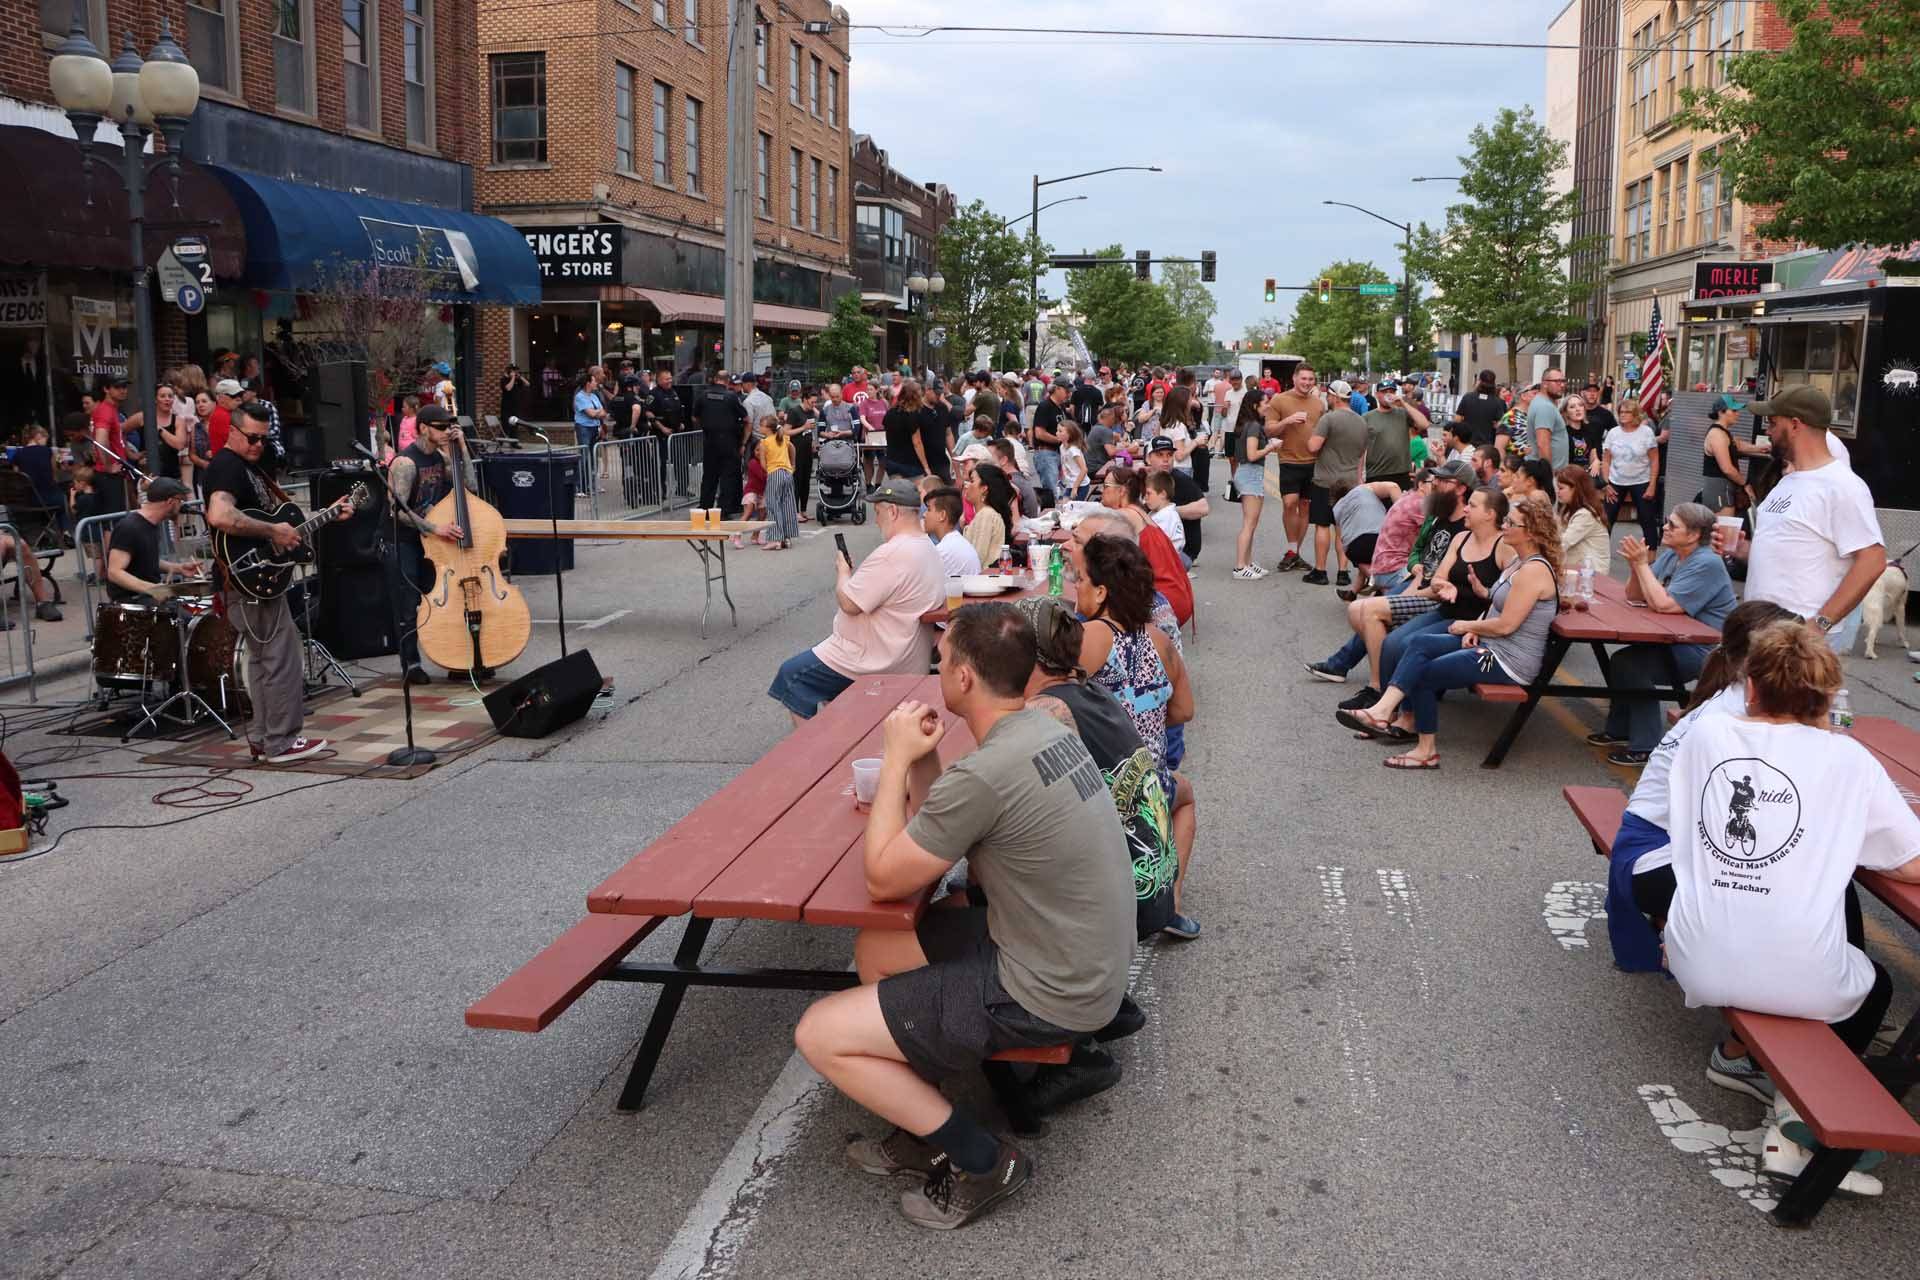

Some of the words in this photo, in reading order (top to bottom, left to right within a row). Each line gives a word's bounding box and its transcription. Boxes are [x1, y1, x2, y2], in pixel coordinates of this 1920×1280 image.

[375, 239, 411, 264] Scott
[198, 263, 213, 283] 2
[538, 262, 555, 276] T.
[562, 262, 613, 276] STORE
[1711, 268, 1759, 285] MERLE
[1699, 288, 1760, 300] NORM
[72, 311, 128, 358] Male
[76, 360, 128, 376] Fashions
[1032, 732, 1090, 788] AMERIC
[1068, 756, 1105, 802] MAD
[1757, 787, 1794, 805] ride
[1711, 850, 1744, 870] Critical
[1746, 860, 1769, 870] Mass
[1769, 848, 1791, 864] Ride
[1729, 870, 1753, 880] Memory
[1711, 879, 1730, 889] Jim
[1731, 881, 1771, 895] Zachary
